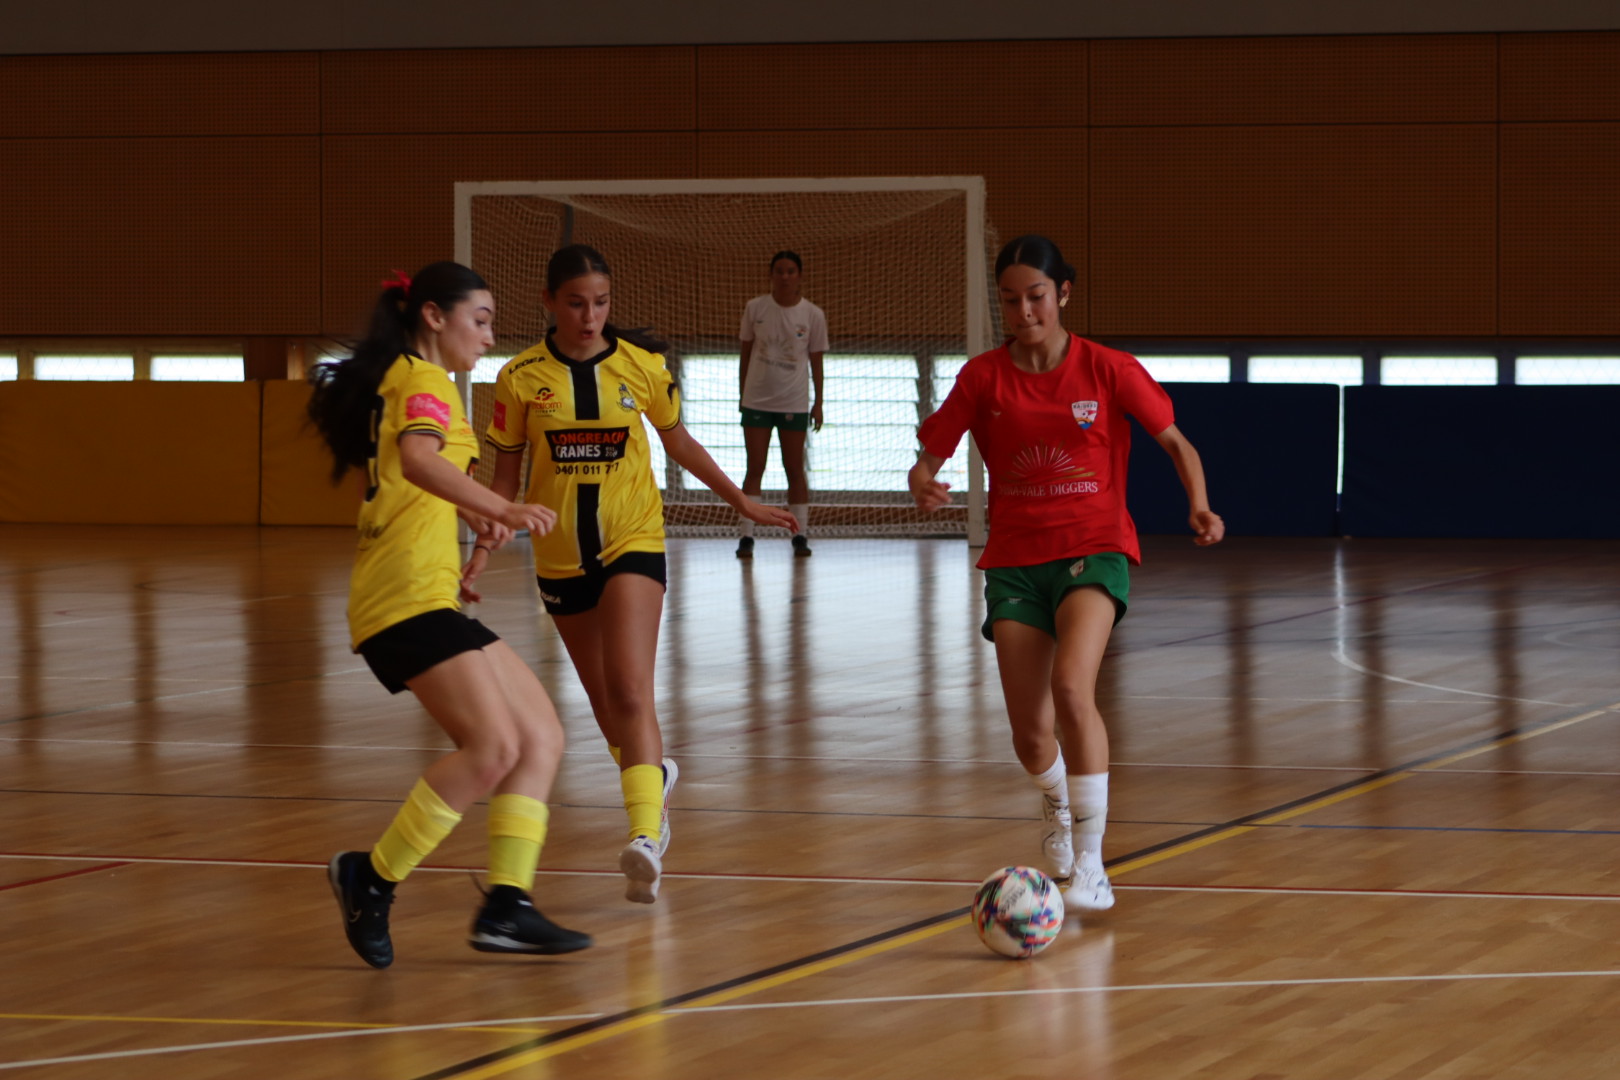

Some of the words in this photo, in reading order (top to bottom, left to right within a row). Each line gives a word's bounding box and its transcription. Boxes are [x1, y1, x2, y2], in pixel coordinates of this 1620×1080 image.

[551, 431, 626, 446] LONGREACH
[555, 445, 601, 458] CRANES
[556, 465, 579, 475] 0401
[582, 464, 601, 475] 011
[605, 462, 620, 474] 77
[1050, 481, 1099, 496] DIGGERS
